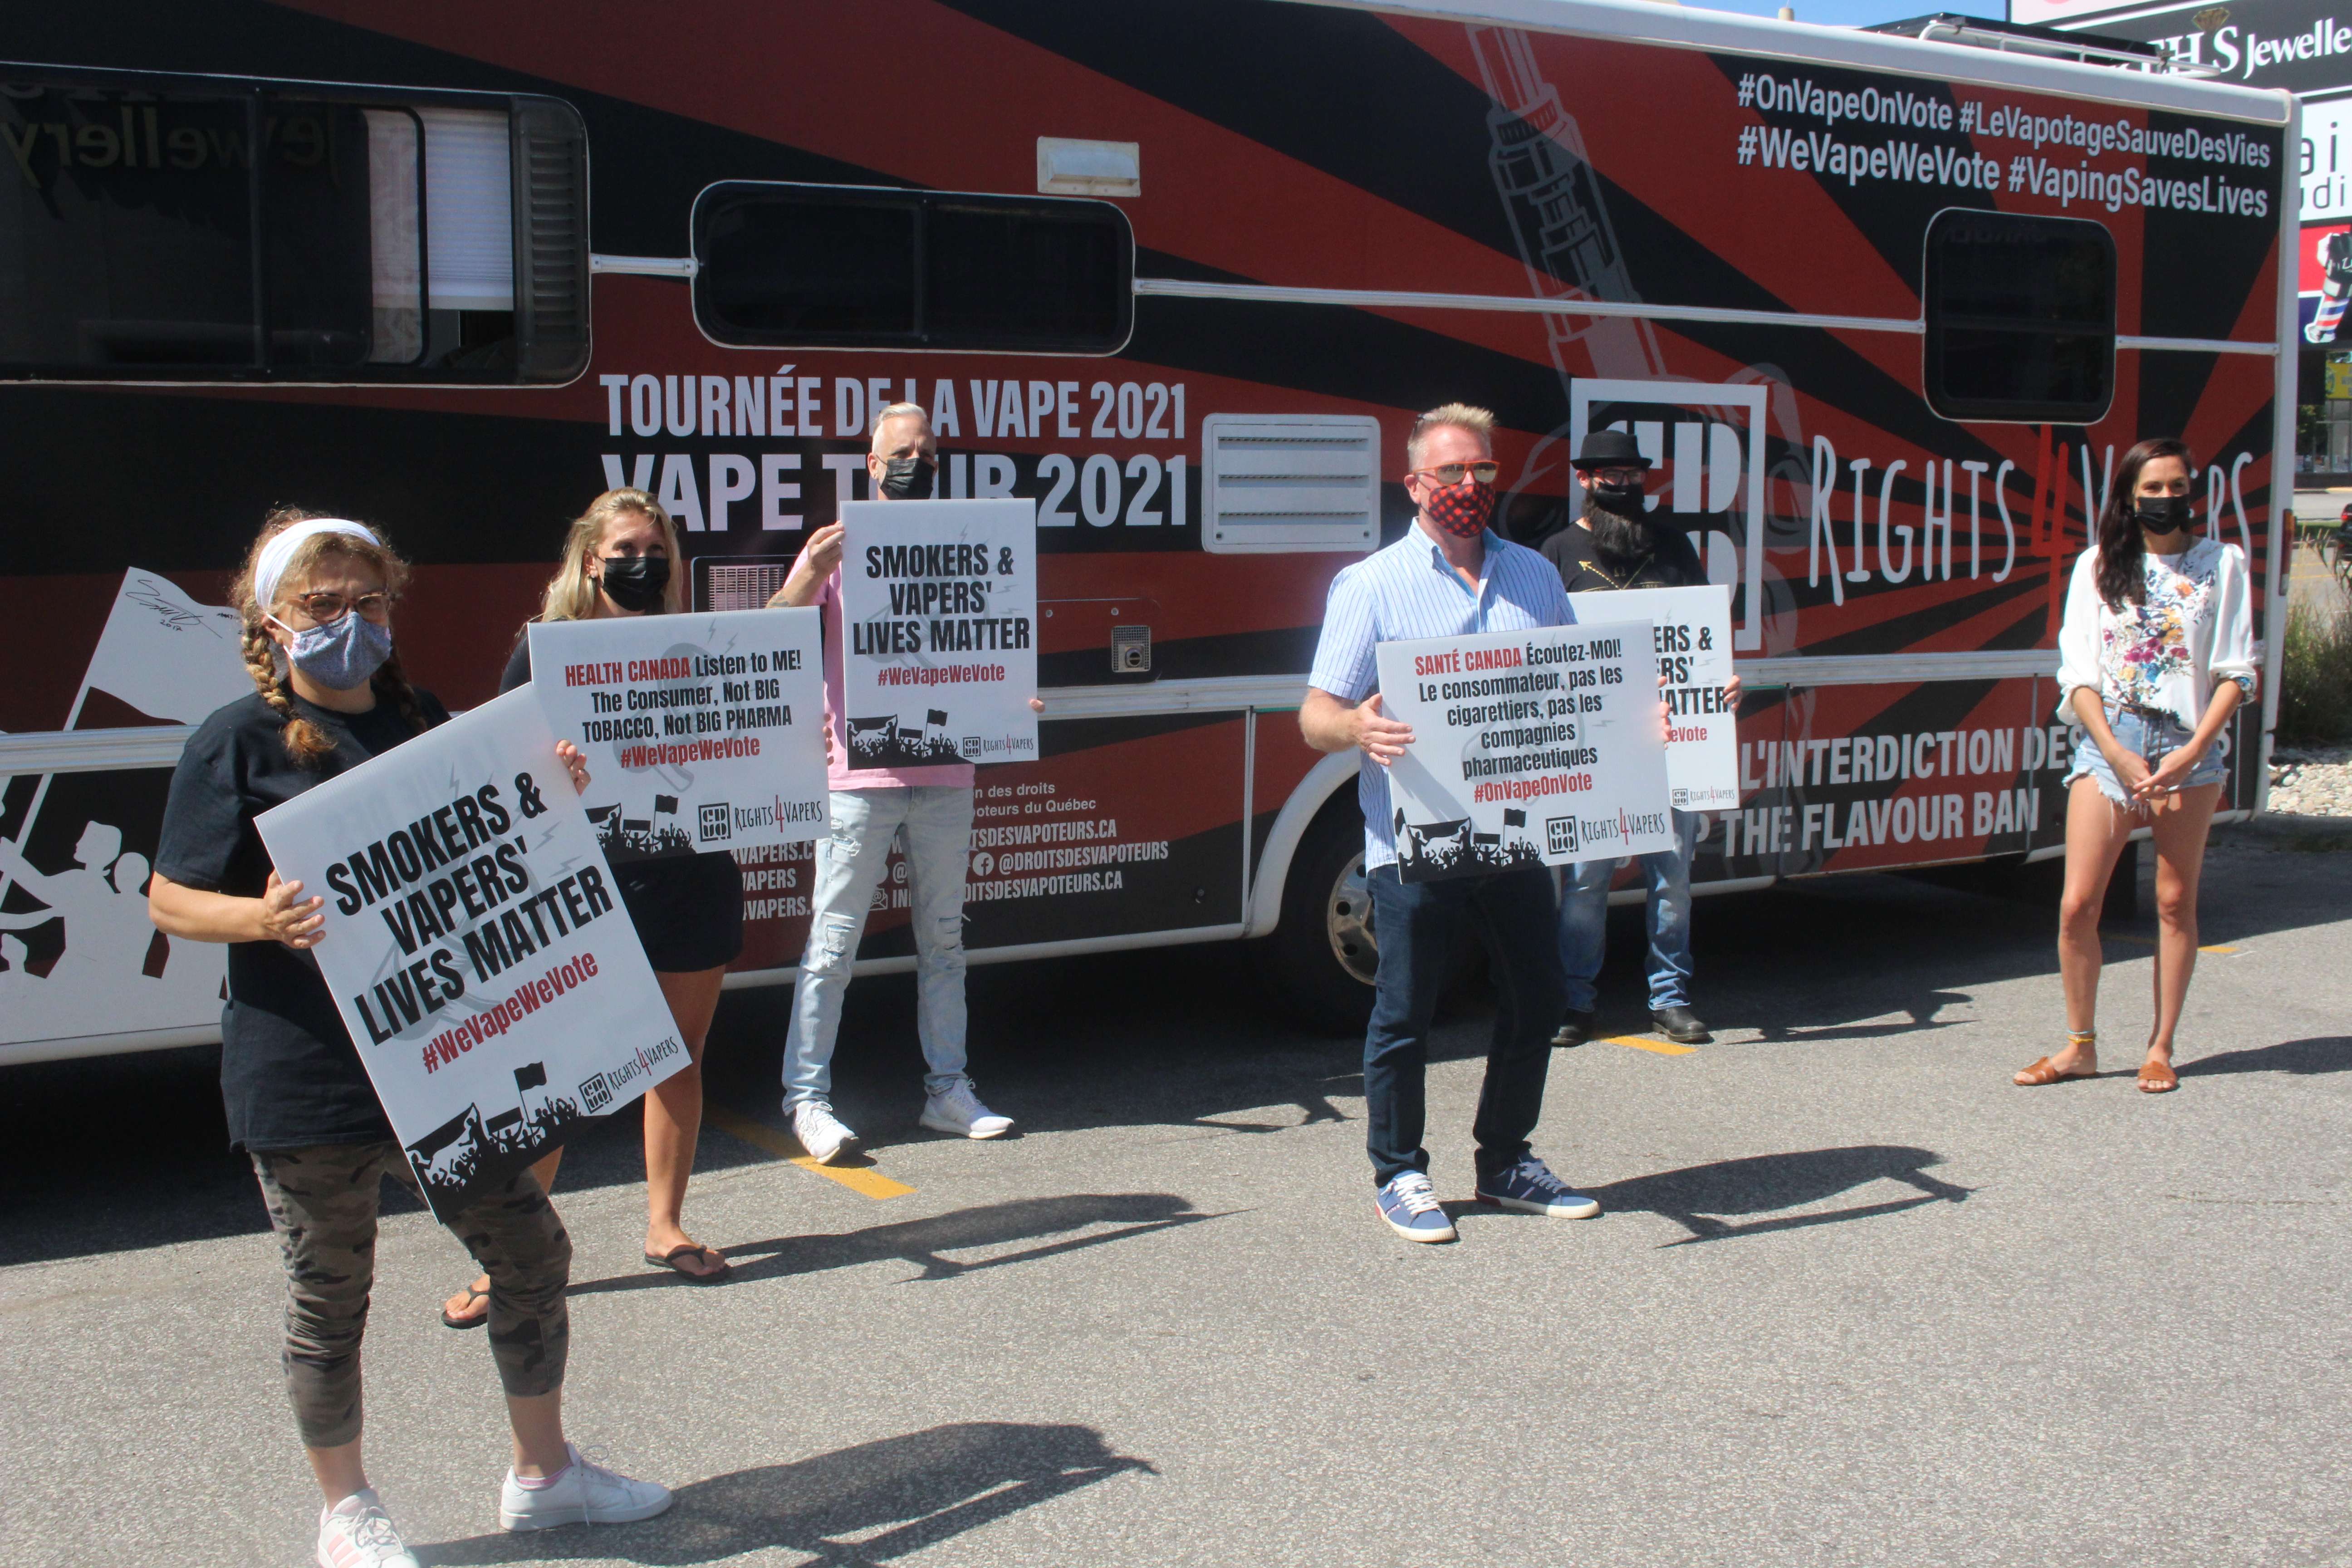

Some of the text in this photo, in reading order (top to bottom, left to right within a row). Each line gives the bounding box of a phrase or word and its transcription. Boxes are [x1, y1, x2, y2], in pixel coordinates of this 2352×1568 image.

[1738, 73, 2270, 168] #OnVapeOnVote #LeVapotageSauveDesVies
[1738, 126, 2269, 217] #WeVapeWeVote #VapingSavesLives
[600, 364, 823, 437] TOURNÉE
[970, 380, 1079, 438] VAPE
[1091, 382, 1185, 439] 2021
[601, 454, 804, 531] VAPE
[1037, 454, 1186, 527] 2021
[866, 544, 1014, 578] SMOKERS &
[889, 581, 991, 615] VAPERS'
[853, 618, 1029, 655] LIVES MATTER
[1699, 627, 1712, 651] &
[565, 650, 802, 687] HEALTH CANADA Listen to ME!
[878, 663, 1005, 686] #WeVapeWeVote
[1415, 638, 1622, 676] SANTÉ CANADA Écoutez-MOI!
[592, 679, 780, 713] The Consumer, Not BIG
[1419, 667, 1622, 702] Le consommateur, pas les
[1659, 686, 1728, 715] ATTER
[583, 705, 792, 743] TOBACCO, Not BIG PHARMA
[1447, 694, 1602, 727] cigarettiers, pas les
[621, 736, 760, 768] #WeVapeWeVote
[1481, 724, 1575, 750] compagnies
[1462, 747, 1597, 780] pharmaceutiques
[1742, 729, 2014, 789] L'INTERDICTION
[988, 786, 1012, 798] des
[1017, 783, 1055, 796] droits
[1474, 772, 1592, 803] #OnVapeOnVote
[1024, 802, 1042, 813] du
[1046, 799, 1096, 813] Québec
[1720, 806, 1792, 858] THE
[1802, 794, 1965, 852] FLAVOUR
[1979, 788, 2039, 837] BAN
[326, 772, 548, 916] SMOKERS &
[999, 841, 1168, 875] @DROITSDESVAPOTEURS
[381, 835, 529, 956] VAPERS'
[354, 865, 613, 1046] LIVES MATTER
[422, 953, 598, 1074] #WeVapeWeVote
